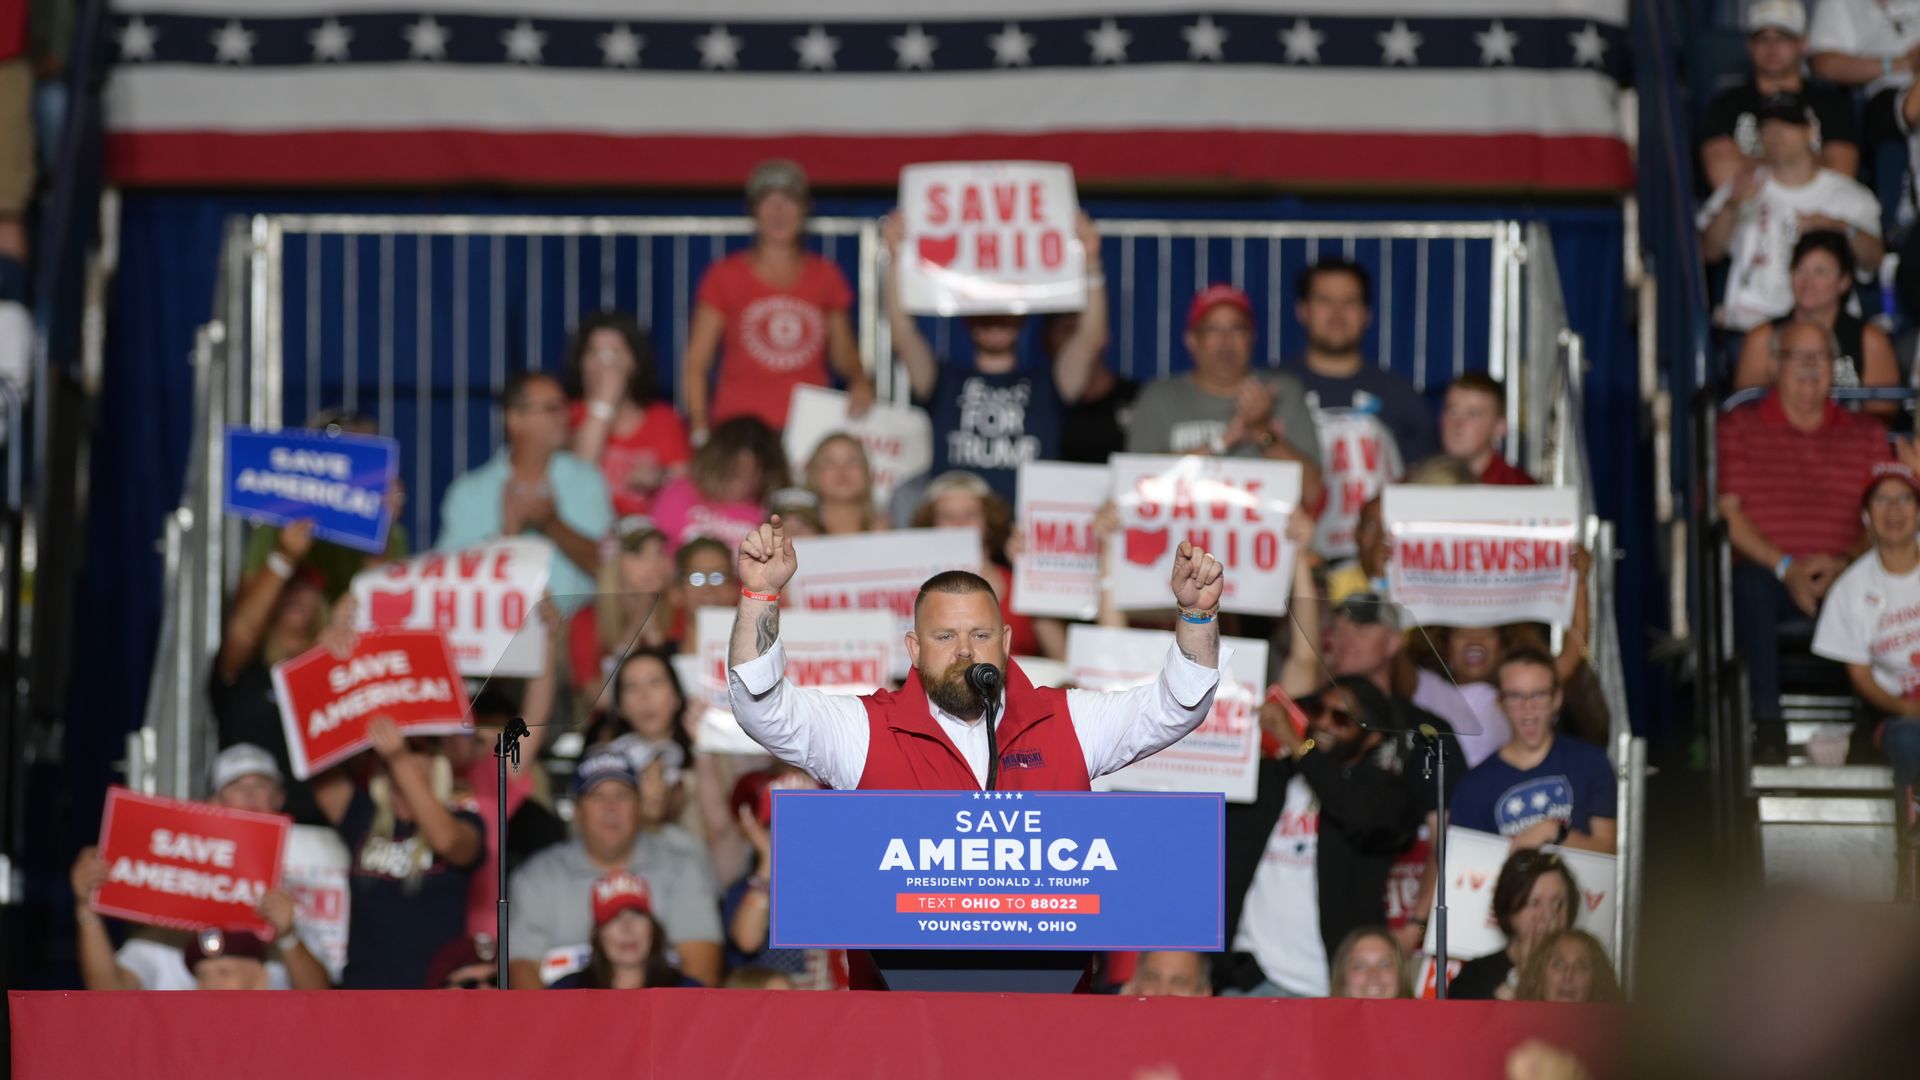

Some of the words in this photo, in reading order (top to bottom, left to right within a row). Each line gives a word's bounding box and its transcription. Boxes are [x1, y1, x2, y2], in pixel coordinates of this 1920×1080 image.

[926, 182, 1043, 225] SAVE
[270, 447, 351, 480] SAVE
[234, 467, 380, 520] AMERICA!
[386, 552, 512, 582] SAVE
[1401, 539, 1562, 572] MAJEWSKI
[329, 651, 411, 692] SAVE
[955, 811, 1042, 833] SAVE
[151, 829, 236, 868] SAVE
[879, 838, 1118, 871] AMERICA
[906, 877, 974, 887] PRESIDENT
[978, 877, 1030, 887] DONALD
[1034, 878, 1044, 887] J.
[1048, 878, 1090, 887] TRUMP
[918, 897, 956, 909] TEXT
[961, 898, 1000, 909] OHIO
[1005, 898, 1025, 909] TO
[1030, 899, 1078, 909] 88022
[918, 920, 1033, 933] YOUNGSTOWN,
[1037, 921, 1077, 932] OHIO
